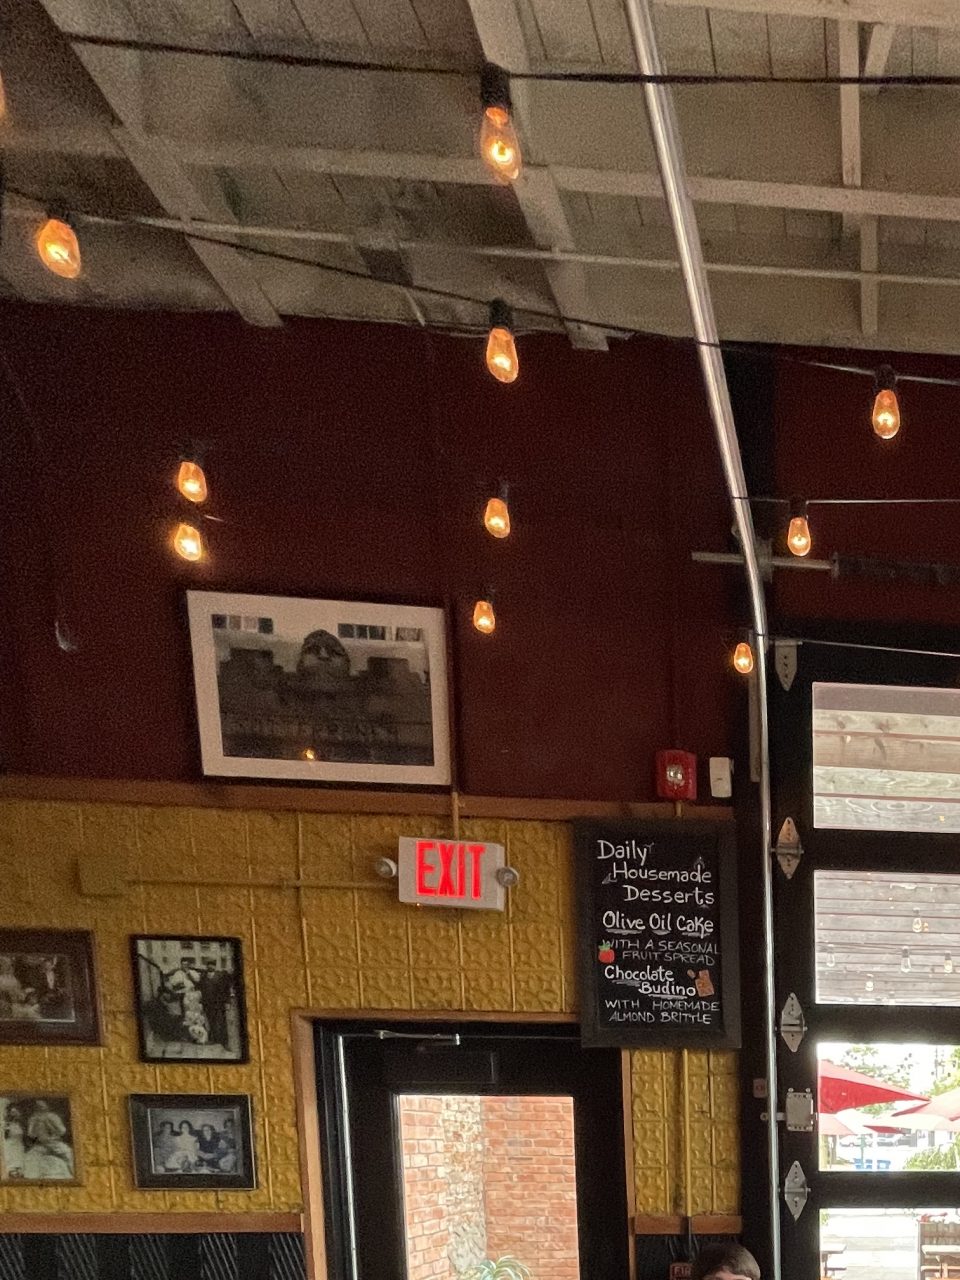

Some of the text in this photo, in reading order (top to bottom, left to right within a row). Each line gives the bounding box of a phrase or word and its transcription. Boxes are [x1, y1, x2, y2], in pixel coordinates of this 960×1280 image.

[597, 840, 647, 866] Daily
[415, 841, 486, 900] EXIT
[613, 861, 712, 883] Housemade
[622, 884, 715, 905] Desserts
[602, 910, 646, 930] Olive
[649, 912, 672, 931] Oil
[602, 939, 719, 954] WITH A SEASONAL
[622, 950, 715, 966] FRUIT SPREAD
[604, 965, 675, 982] Chocolate
[638, 981, 697, 996] Budino
[604, 999, 720, 1011] WITH HOMEMADE
[608, 1011, 712, 1025] ALMOND BRITTLE
